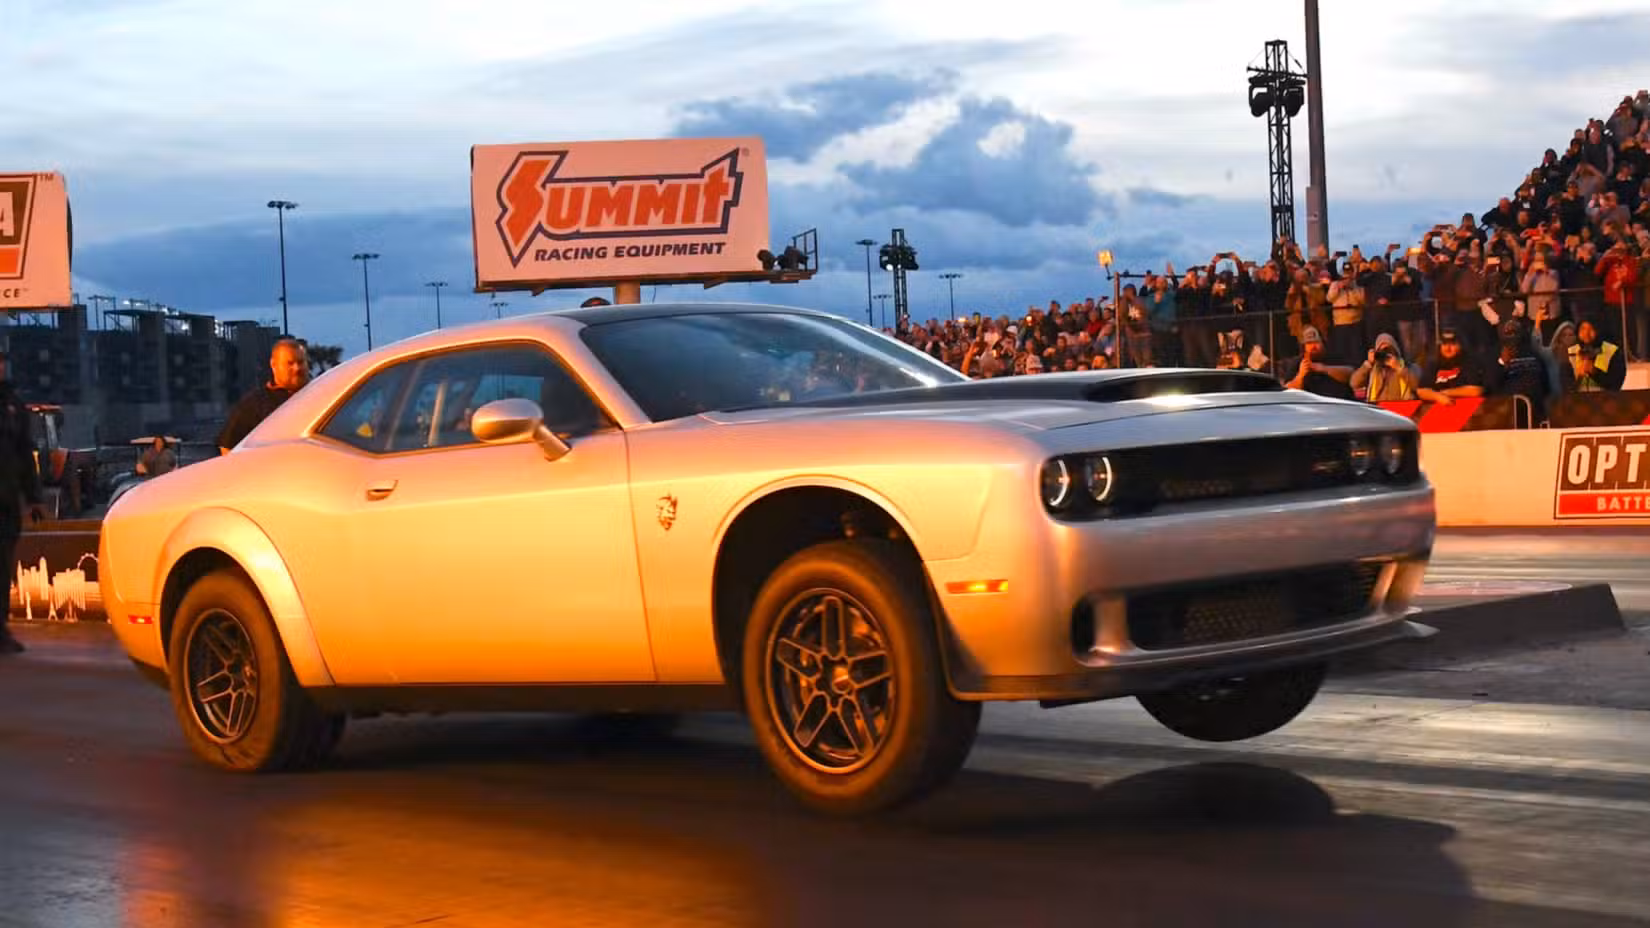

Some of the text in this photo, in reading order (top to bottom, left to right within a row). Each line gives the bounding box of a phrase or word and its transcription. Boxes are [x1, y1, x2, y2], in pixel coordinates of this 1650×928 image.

[534, 242, 726, 262] RACING EQUIPMENT
[1567, 443, 1648, 485] OPT
